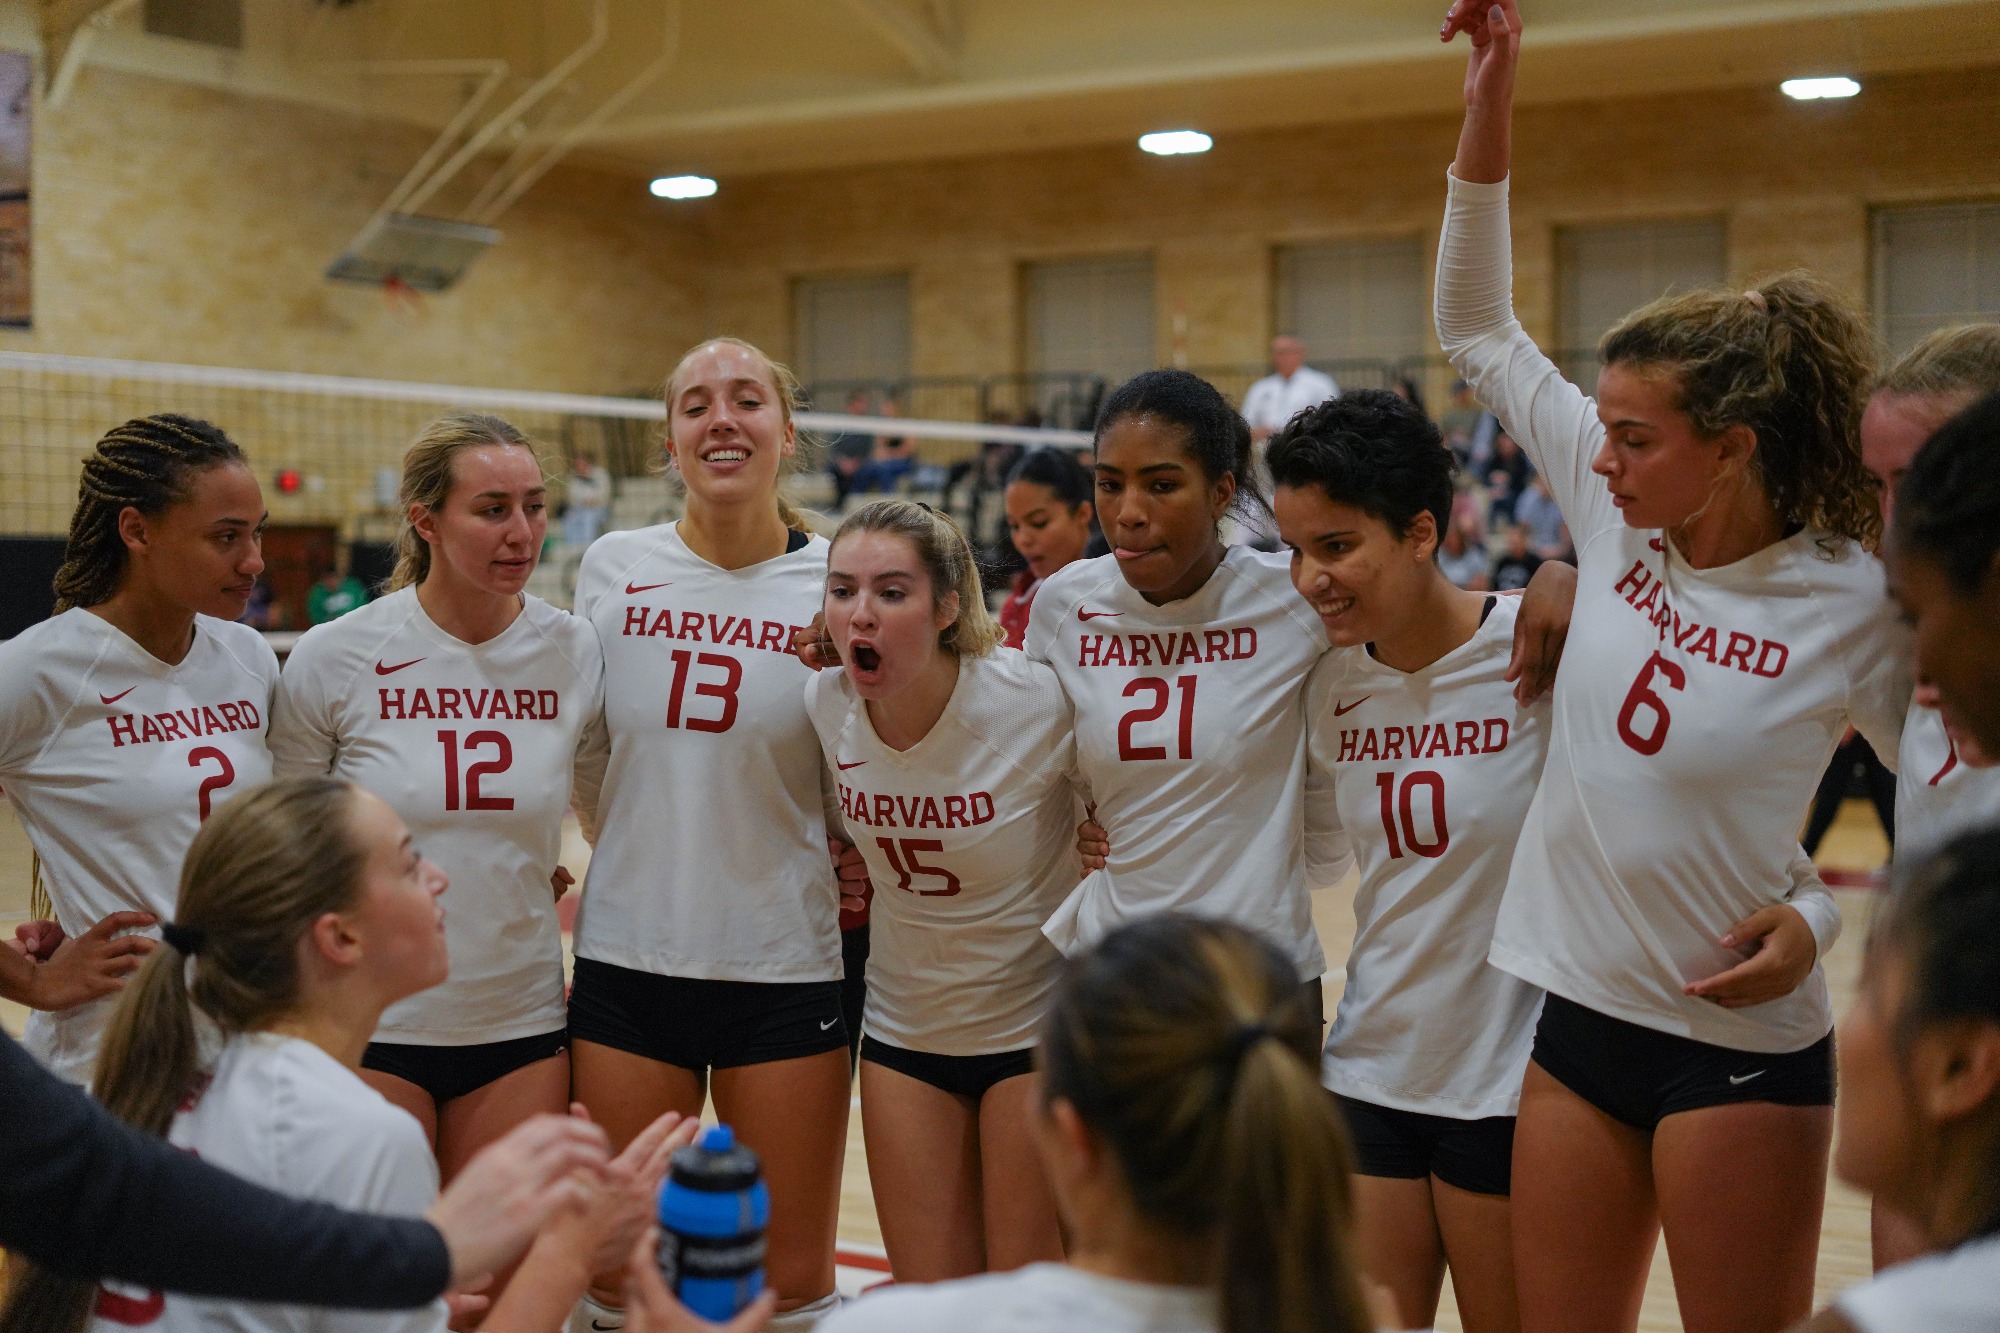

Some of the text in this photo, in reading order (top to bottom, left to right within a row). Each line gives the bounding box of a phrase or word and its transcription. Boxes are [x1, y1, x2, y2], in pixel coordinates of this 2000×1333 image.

[1078, 627, 1258, 667] HARVARD
[1614, 559, 1789, 679] HARVARD
[106, 700, 260, 747] HARVARD
[379, 688, 559, 720] HARVARD
[666, 649, 743, 734] 13
[1116, 674, 1198, 762] 21
[1616, 649, 1687, 757] 6
[437, 729, 515, 811] 12
[1336, 717, 1510, 762] HARVARD
[839, 782, 996, 829] HARVARD
[1375, 770, 1450, 859] 10
[875, 836, 961, 896] 15
